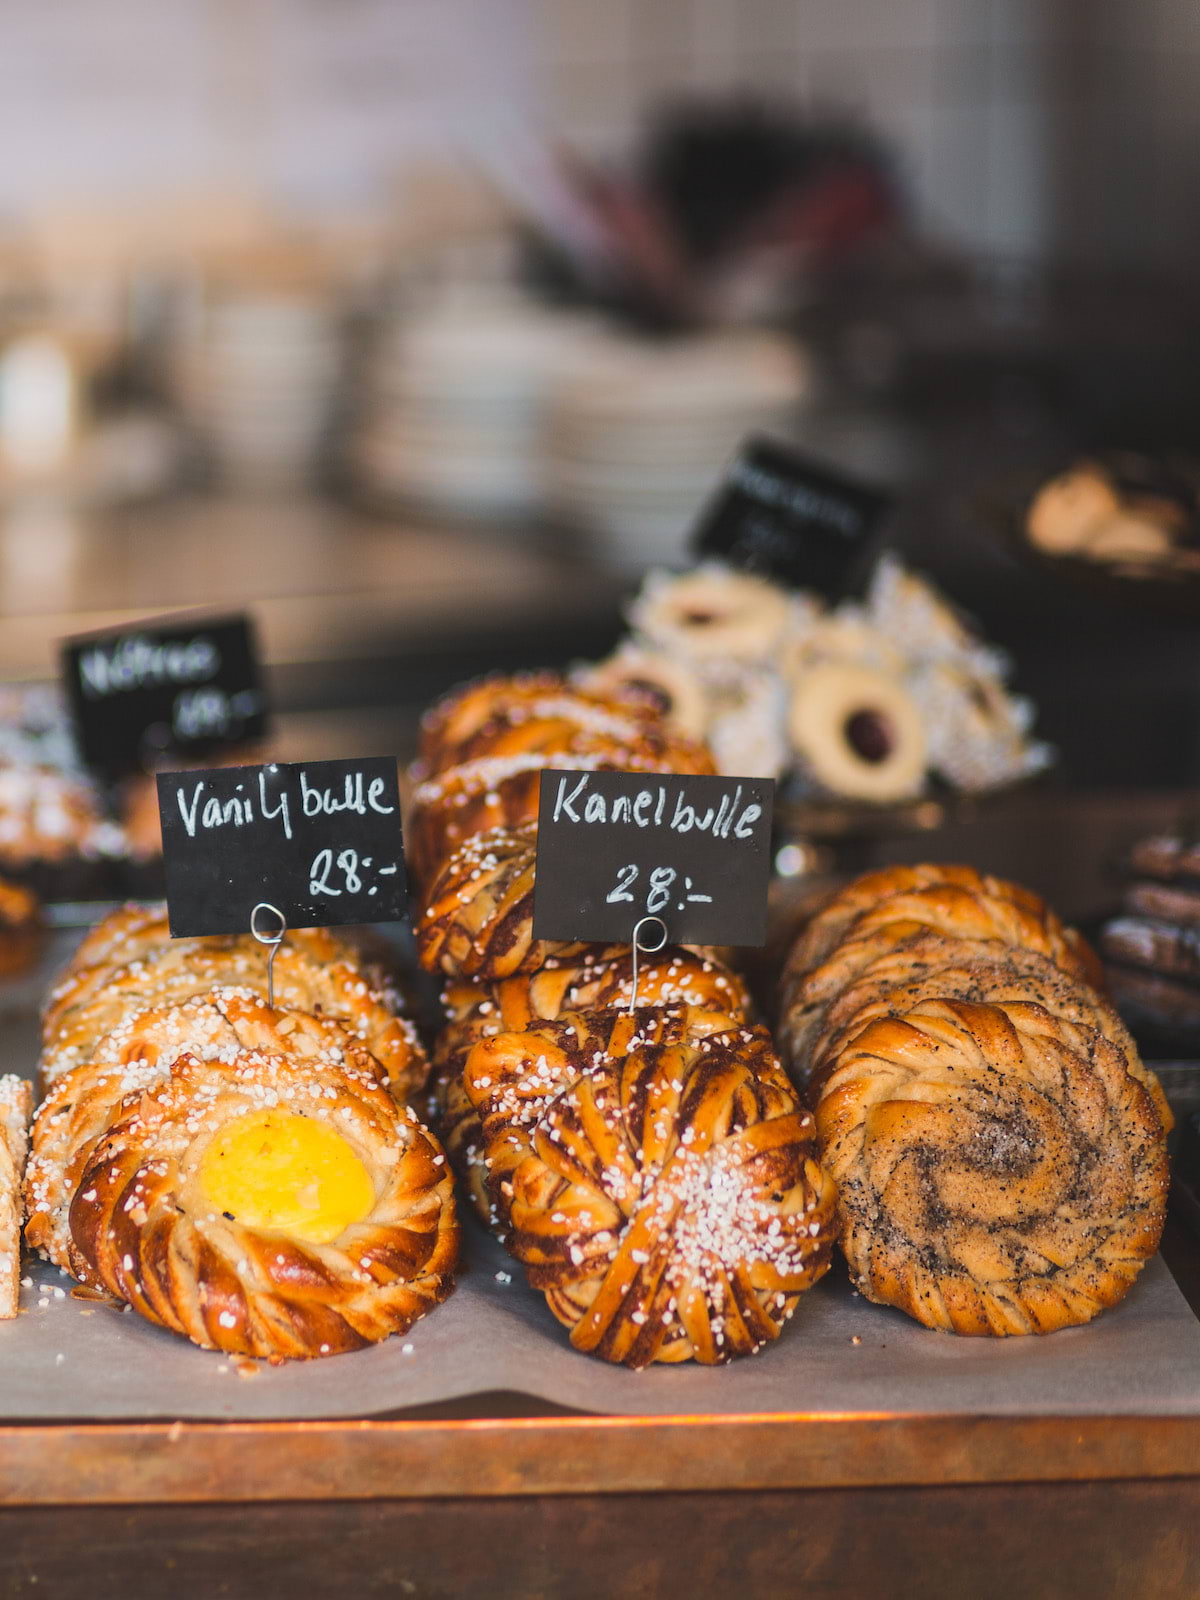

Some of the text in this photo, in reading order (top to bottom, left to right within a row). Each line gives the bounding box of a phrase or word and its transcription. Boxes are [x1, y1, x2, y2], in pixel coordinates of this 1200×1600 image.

[553, 773, 761, 839] Kanelbulle
[309, 849, 397, 896] 28:-
[606, 864, 712, 913] 28:-
